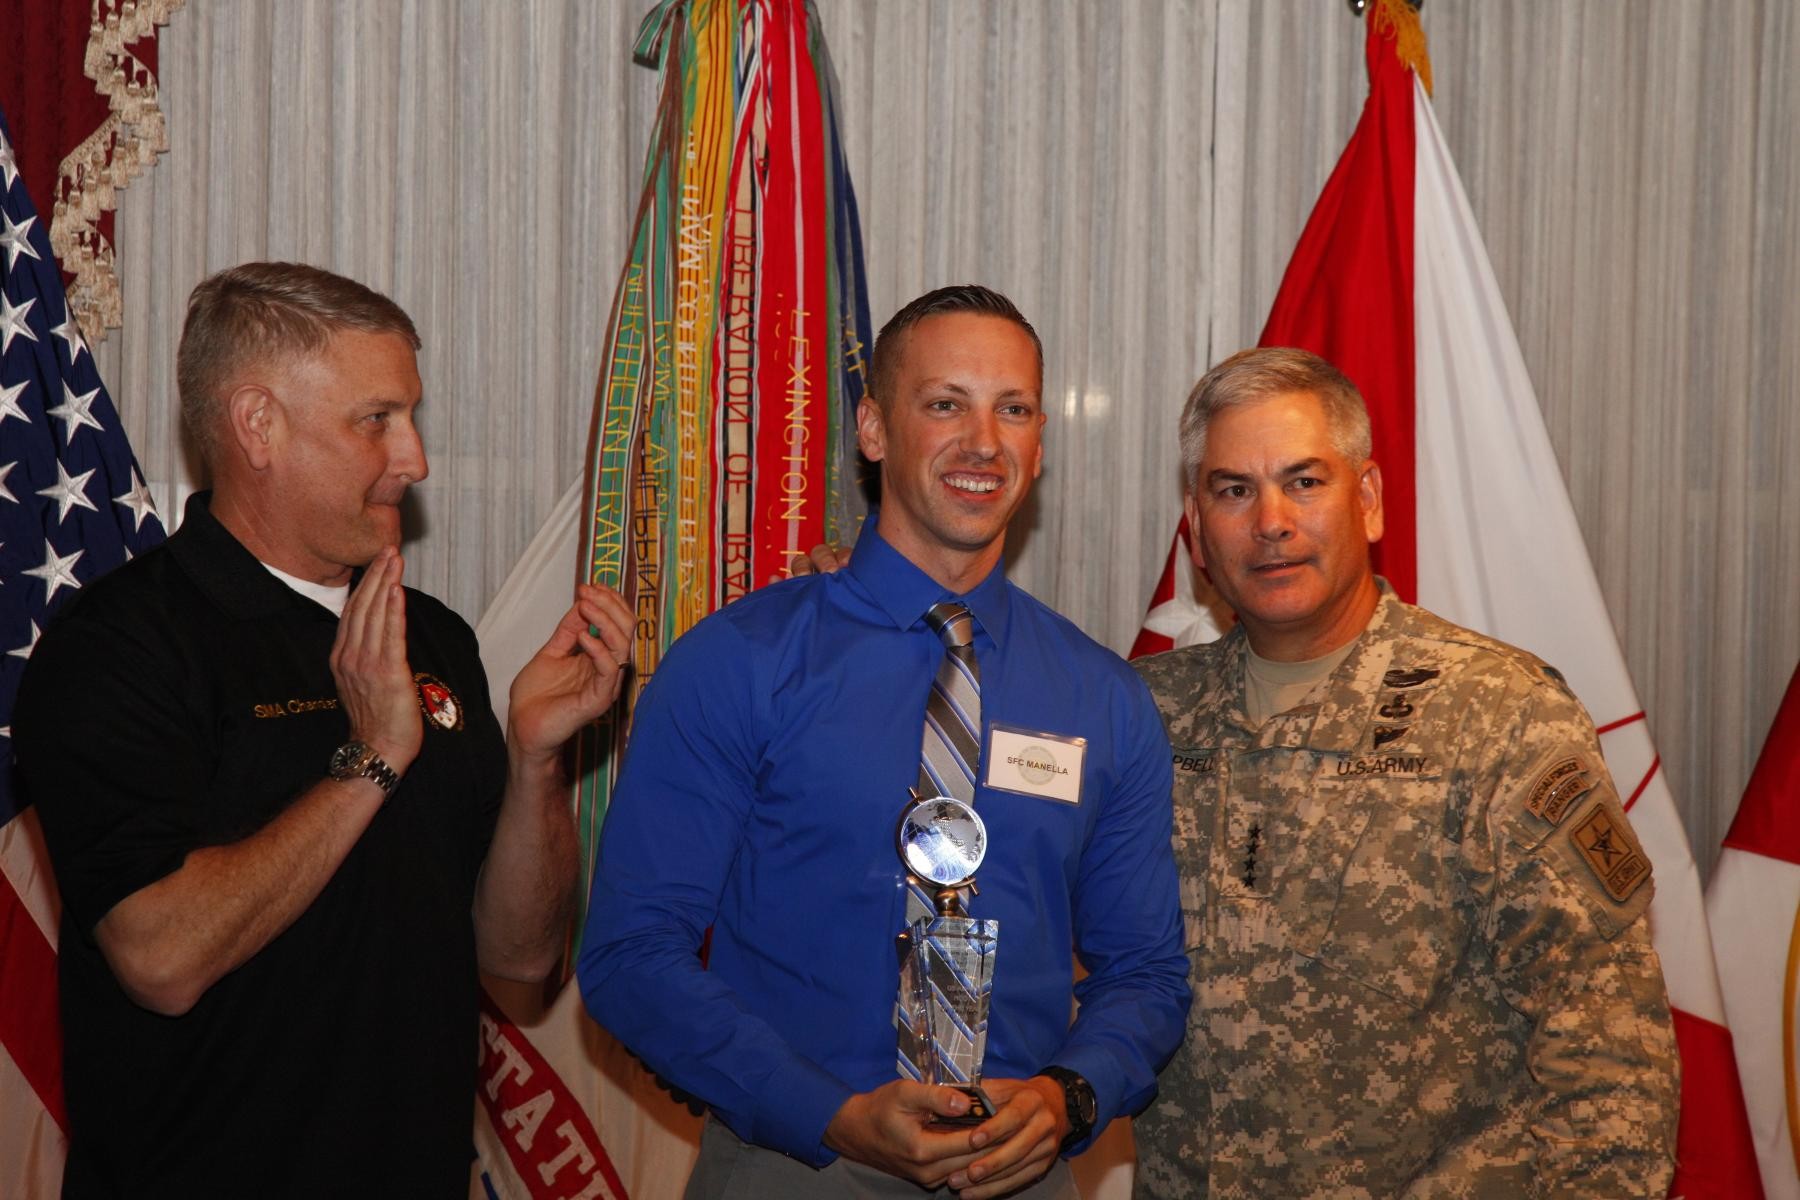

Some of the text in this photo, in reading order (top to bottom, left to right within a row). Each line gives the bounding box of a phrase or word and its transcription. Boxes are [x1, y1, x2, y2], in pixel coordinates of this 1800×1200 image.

[602, 263, 645, 452] NORTHERN
[779, 309, 812, 520] LEXINGTON
[1007, 756, 1069, 775] SFC MANELLA
